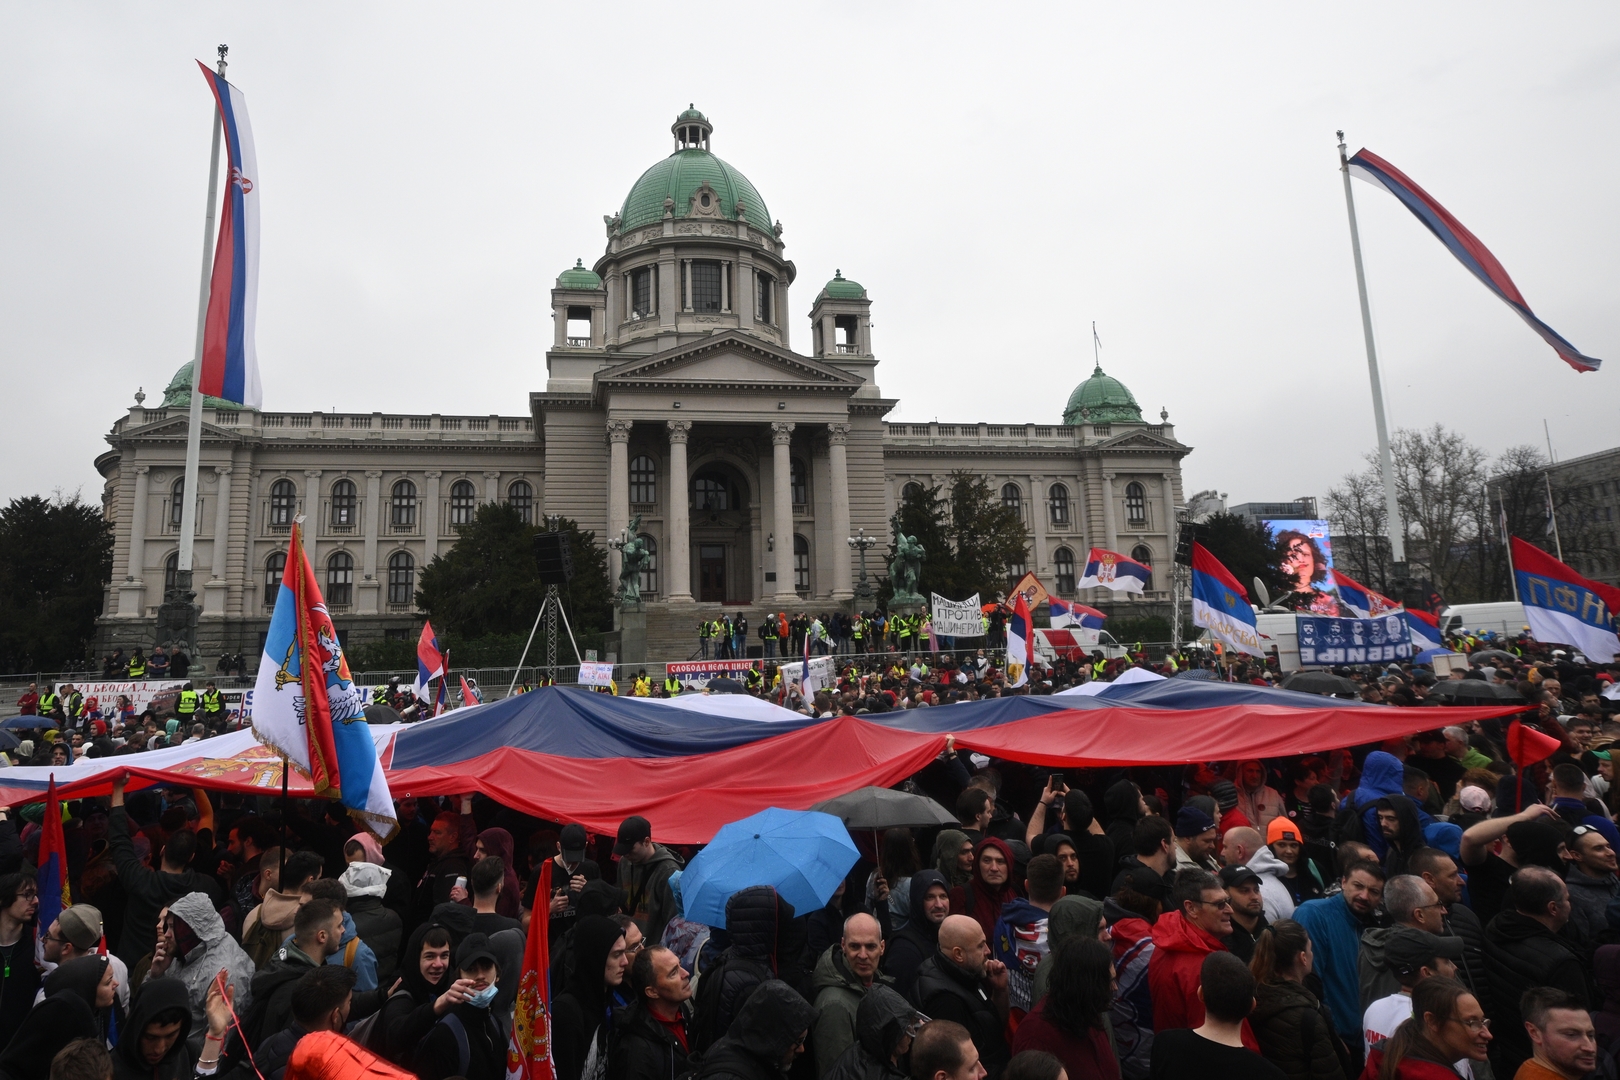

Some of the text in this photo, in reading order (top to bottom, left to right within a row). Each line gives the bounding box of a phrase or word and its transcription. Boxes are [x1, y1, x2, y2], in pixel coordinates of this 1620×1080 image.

[937, 608, 982, 621] ПРОТИВ
[933, 620, 984, 635] МАШИНЕРИЈЕ
[671, 662, 753, 673] СЛОБОДА НЕМА ЦИЈЕН
[77, 684, 90, 693] ЗА
